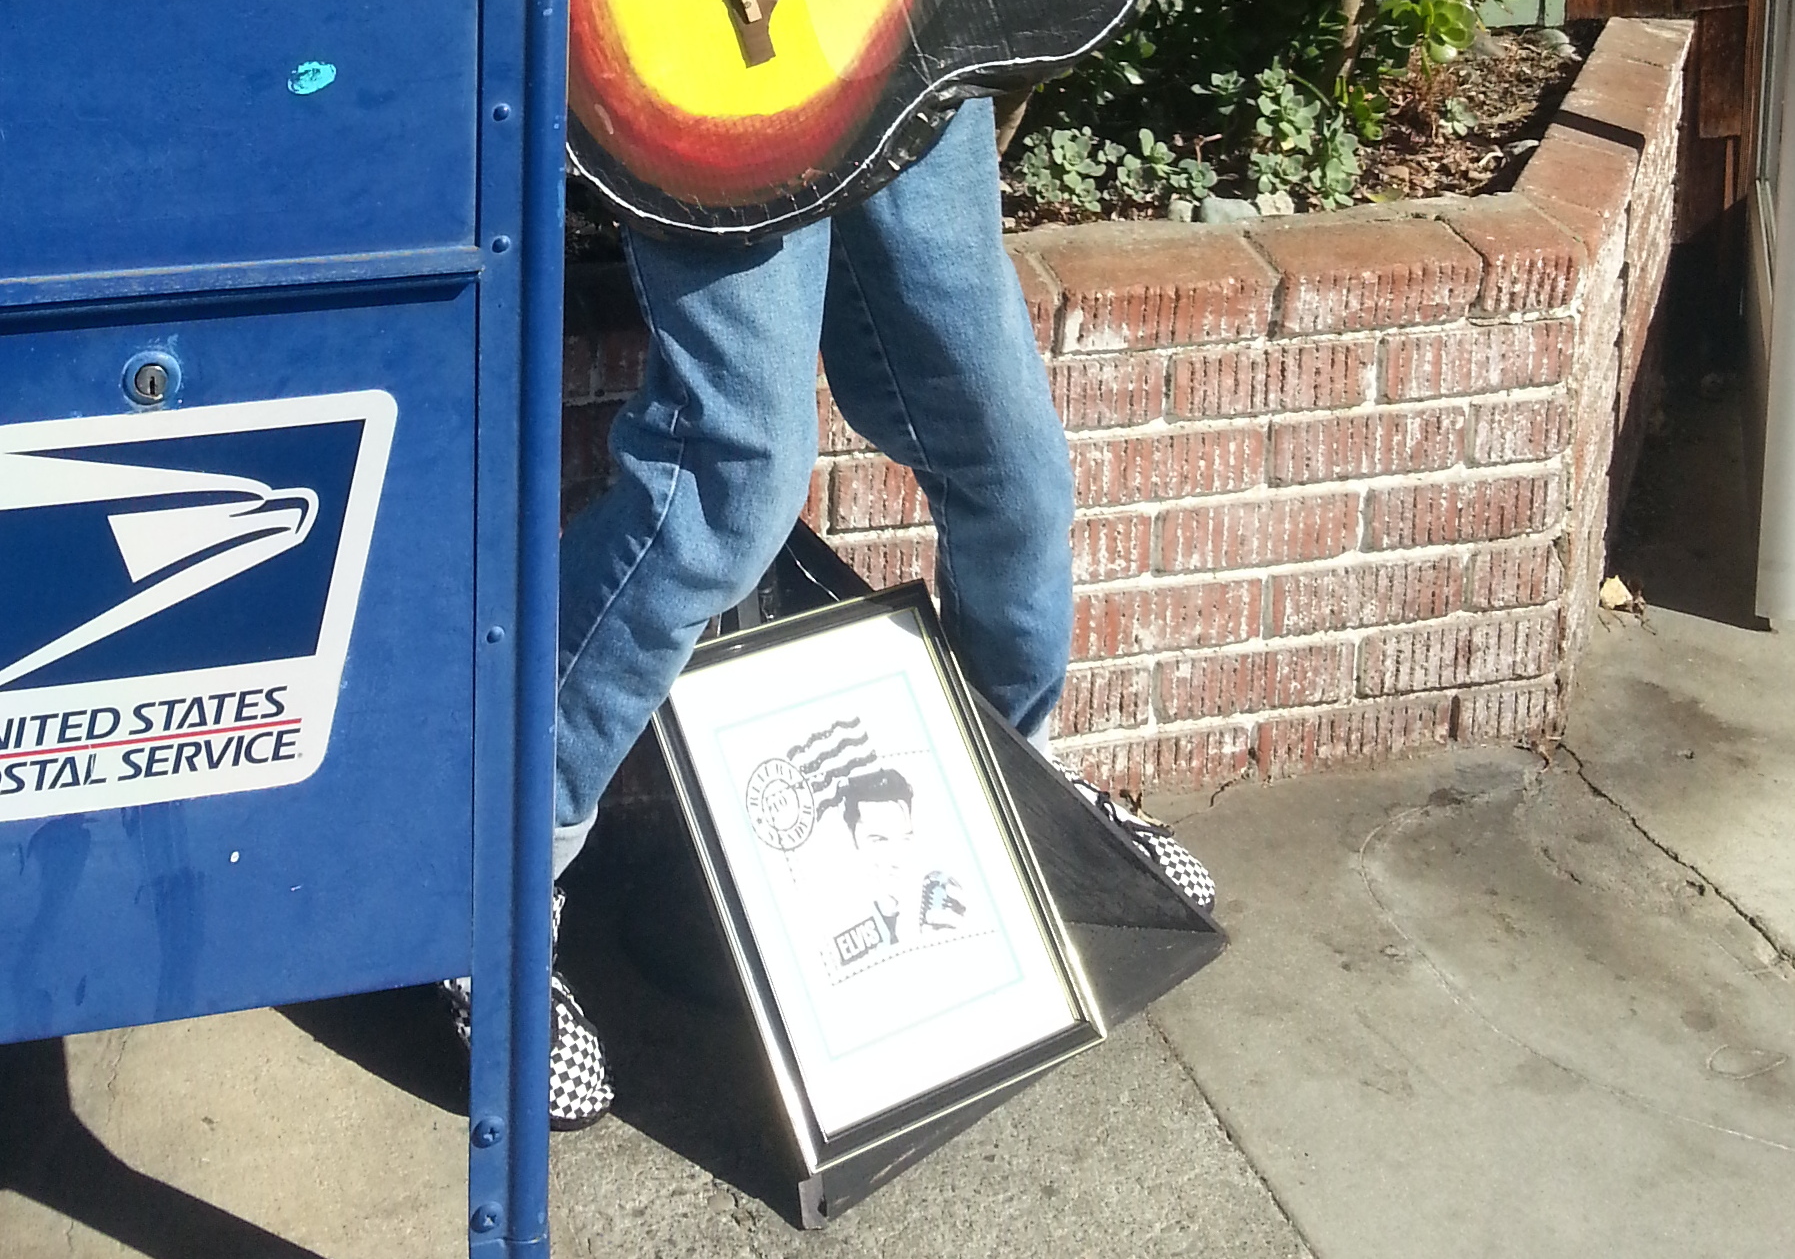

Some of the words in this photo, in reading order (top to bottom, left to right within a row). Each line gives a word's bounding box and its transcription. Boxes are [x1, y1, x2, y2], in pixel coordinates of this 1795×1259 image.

[128, 685, 288, 735] STATES
[0, 753, 107, 795] STAL
[117, 727, 301, 782] SERVICE
[836, 920, 881, 961] ELVIS
